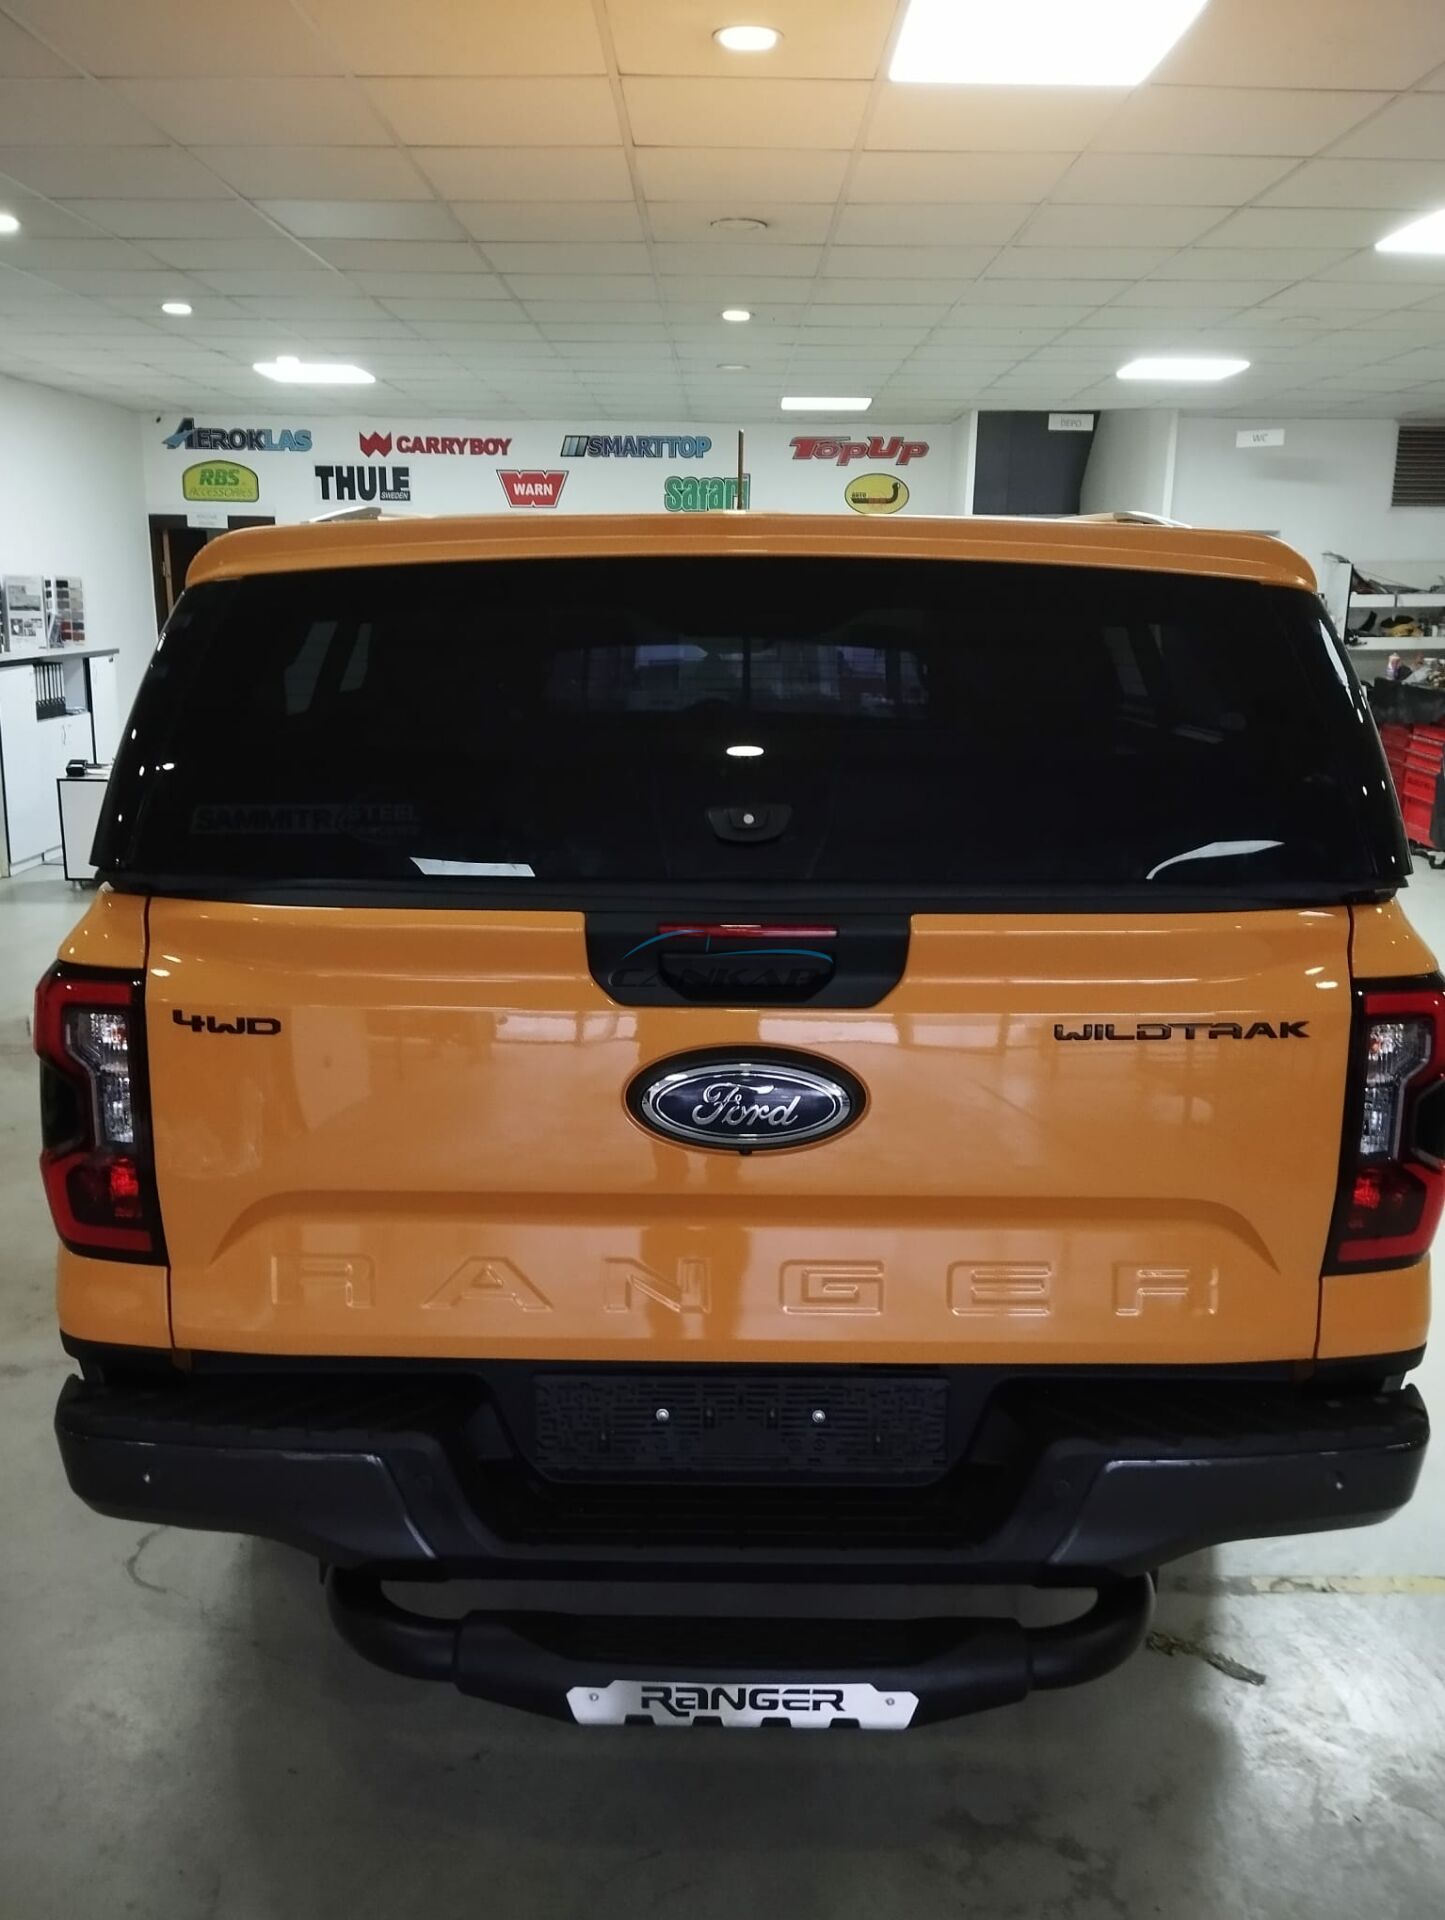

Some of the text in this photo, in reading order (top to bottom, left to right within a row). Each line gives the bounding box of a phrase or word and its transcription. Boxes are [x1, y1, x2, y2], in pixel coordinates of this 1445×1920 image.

[165, 417, 313, 452] AEROKLAS
[396, 435, 512, 456] CARRYBOY
[587, 434, 713, 459] SMARTTOP
[199, 468, 241, 486] RBS
[315, 464, 410, 501] THULE
[513, 481, 553, 497] WARN
[380, 491, 409, 500] SWEDEN
[195, 808, 333, 832] SAMMITR
[172, 1009, 282, 1035] 4WD
[1054, 1020, 1311, 1041] WILDTRAK
[691, 1082, 802, 1126] Ford
[270, 1253, 1220, 1318] RANGER
